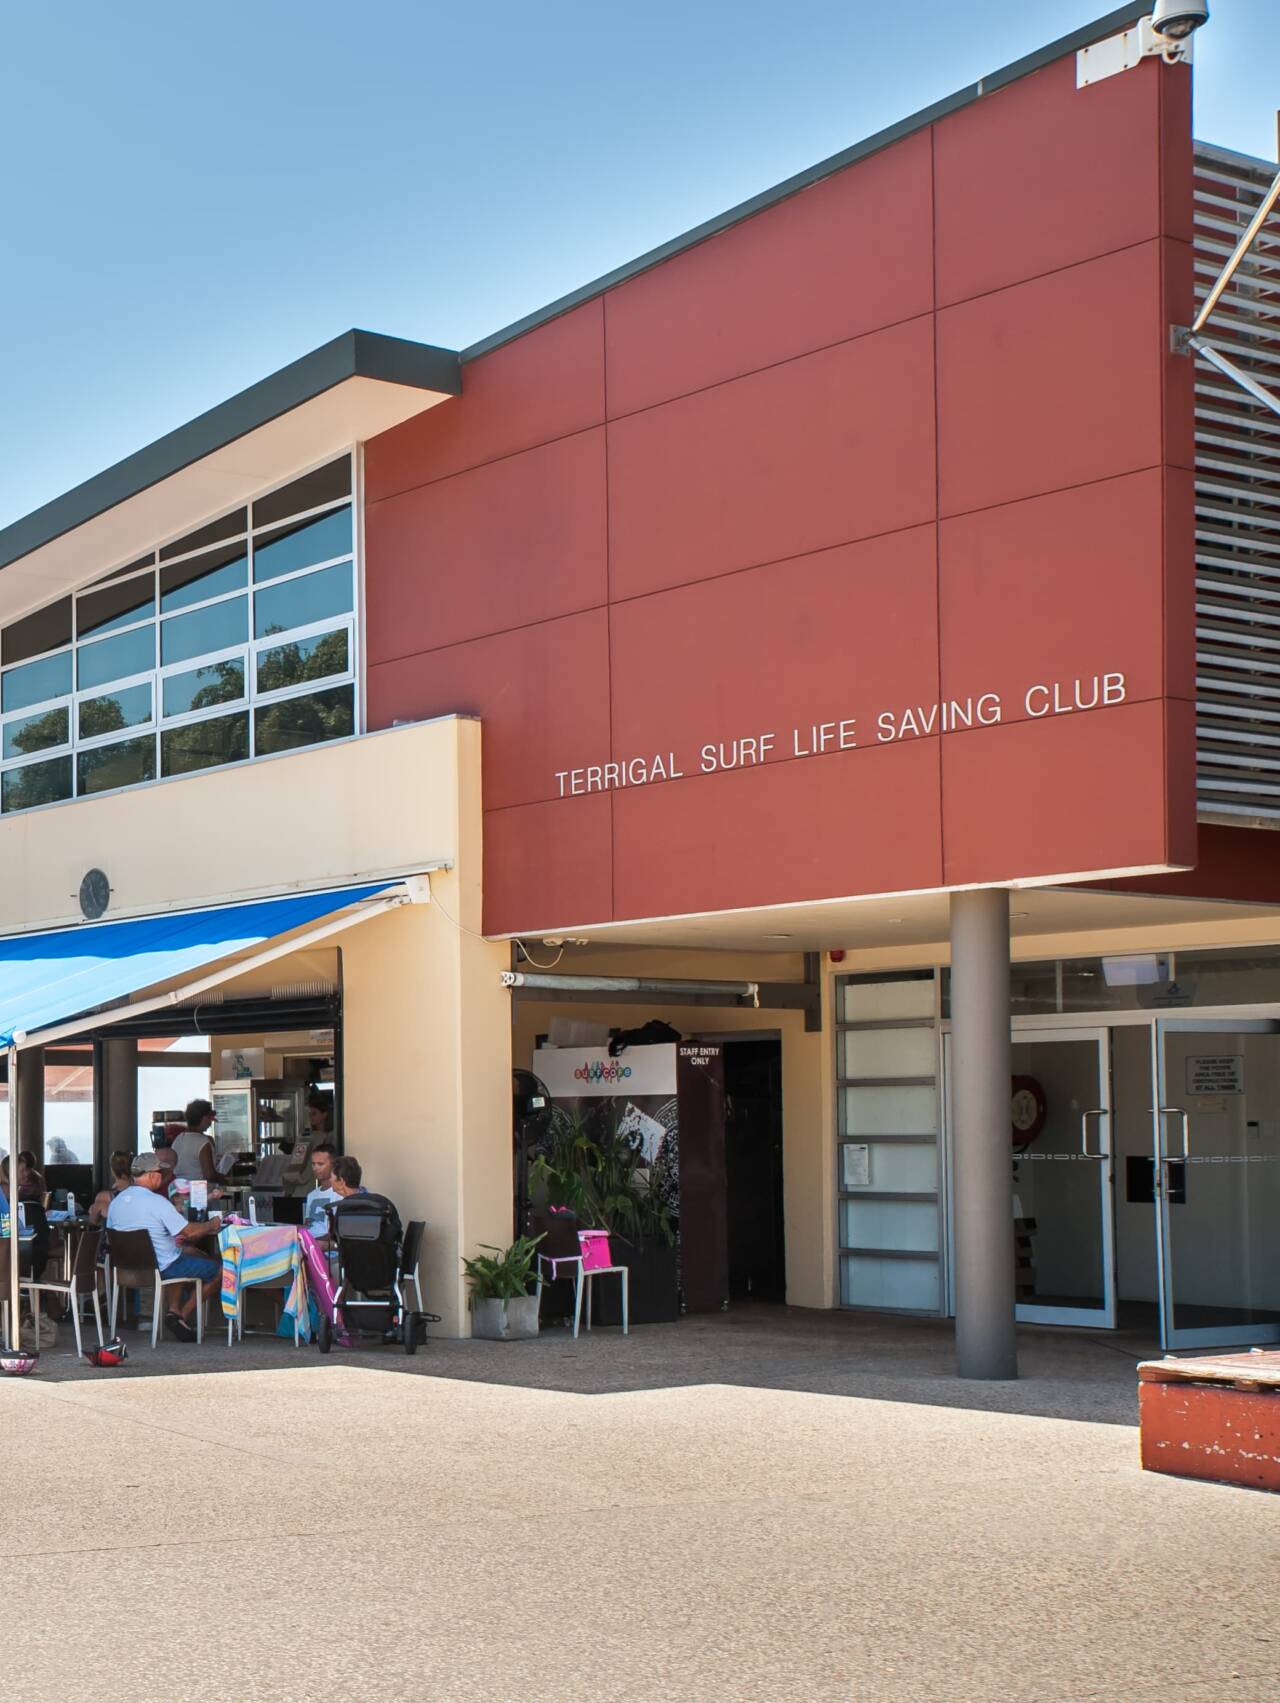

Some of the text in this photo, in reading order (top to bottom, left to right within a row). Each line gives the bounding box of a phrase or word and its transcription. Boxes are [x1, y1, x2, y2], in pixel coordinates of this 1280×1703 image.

[554, 672, 1127, 797] TERRIGAL SURF LIFE SAVING CLUB
[679, 1047, 720, 1056] STAFF ENTRY
[690, 1056, 710, 1065] ONLY
